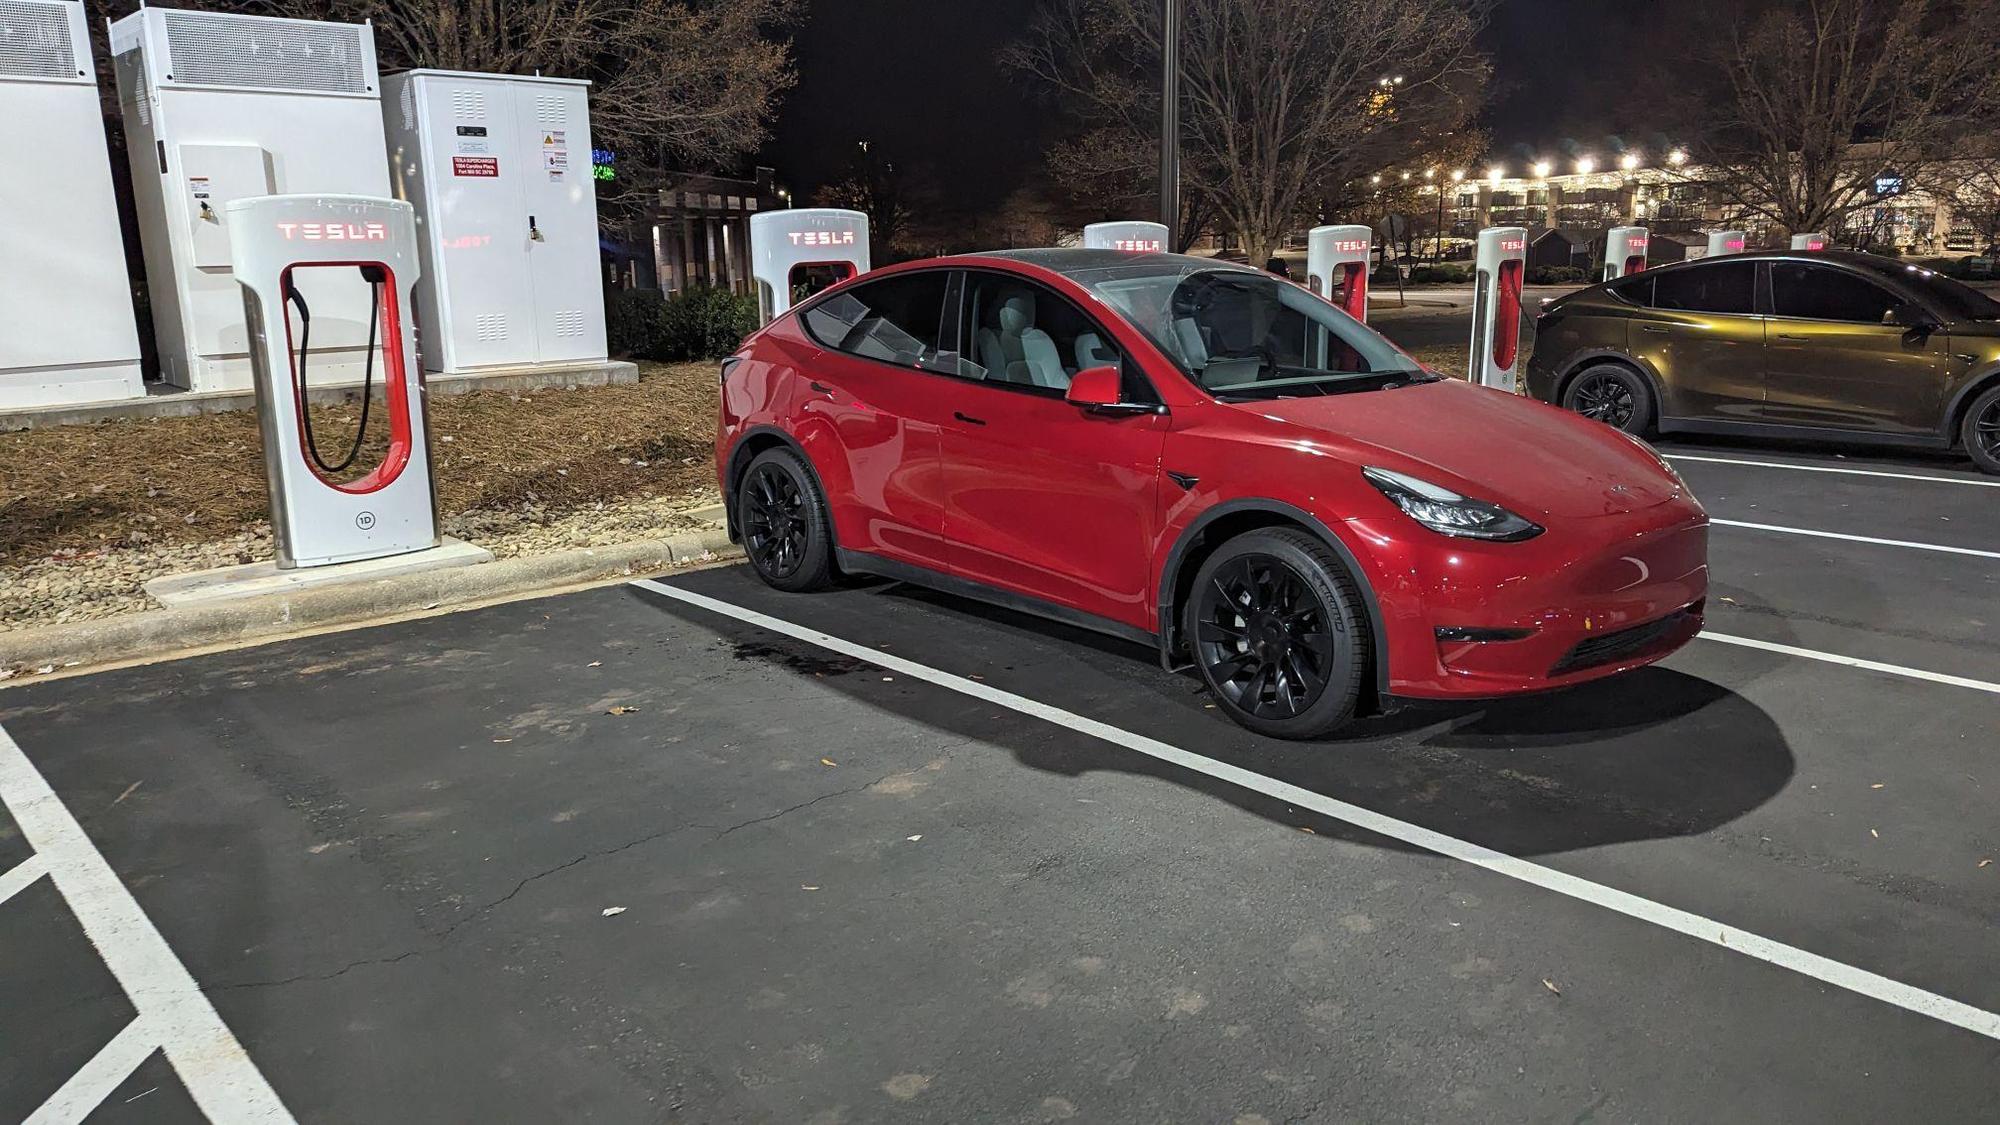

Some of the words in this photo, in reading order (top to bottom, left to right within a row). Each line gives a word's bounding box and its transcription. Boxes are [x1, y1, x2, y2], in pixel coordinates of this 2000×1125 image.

[276, 223, 385, 240] TESLA
[788, 231, 854, 246] TESLA
[1115, 240, 1160, 251] TESLA
[1334, 240, 1367, 252] TESLA
[359, 516, 372, 525] 1D
